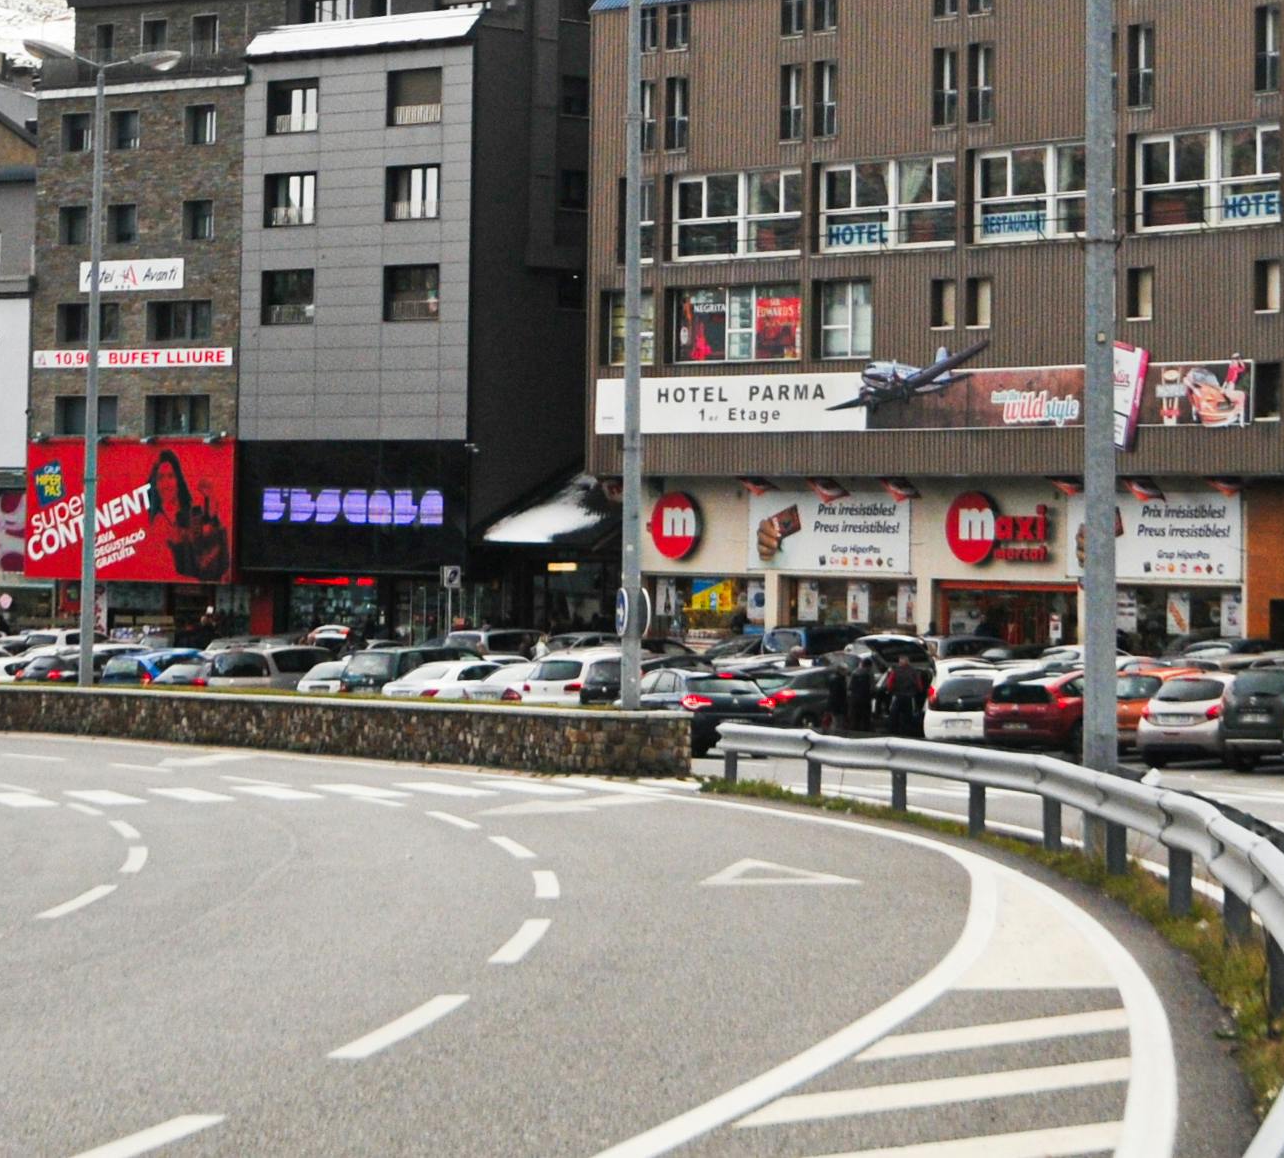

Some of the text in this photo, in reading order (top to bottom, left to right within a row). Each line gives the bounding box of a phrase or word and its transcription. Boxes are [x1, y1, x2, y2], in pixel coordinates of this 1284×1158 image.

[982, 212, 1047, 234] RESTAURANT
[827, 223, 889, 246] HOTEL
[85, 268, 115, 284] Htel
[143, 265, 179, 282] Avanti
[693, 303, 727, 313] NEGRITA
[108, 352, 160, 365] BUFET
[166, 350, 227, 364] LLIURE
[657, 384, 826, 403] HOTEL PARMA
[728, 406, 782, 424] Etage
[36, 473, 61, 486] HIPER
[44, 484, 62, 497] PAS
[817, 504, 837, 516] Prix
[1141, 505, 1162, 518] Prix
[27, 483, 151, 561] CONTNENT
[813, 521, 900, 534] Preus irresistibles!
[958, 505, 1047, 540] maxi
[1137, 524, 1231, 538] Preus irresistibles!
[1157, 549, 1175, 560] Grup
